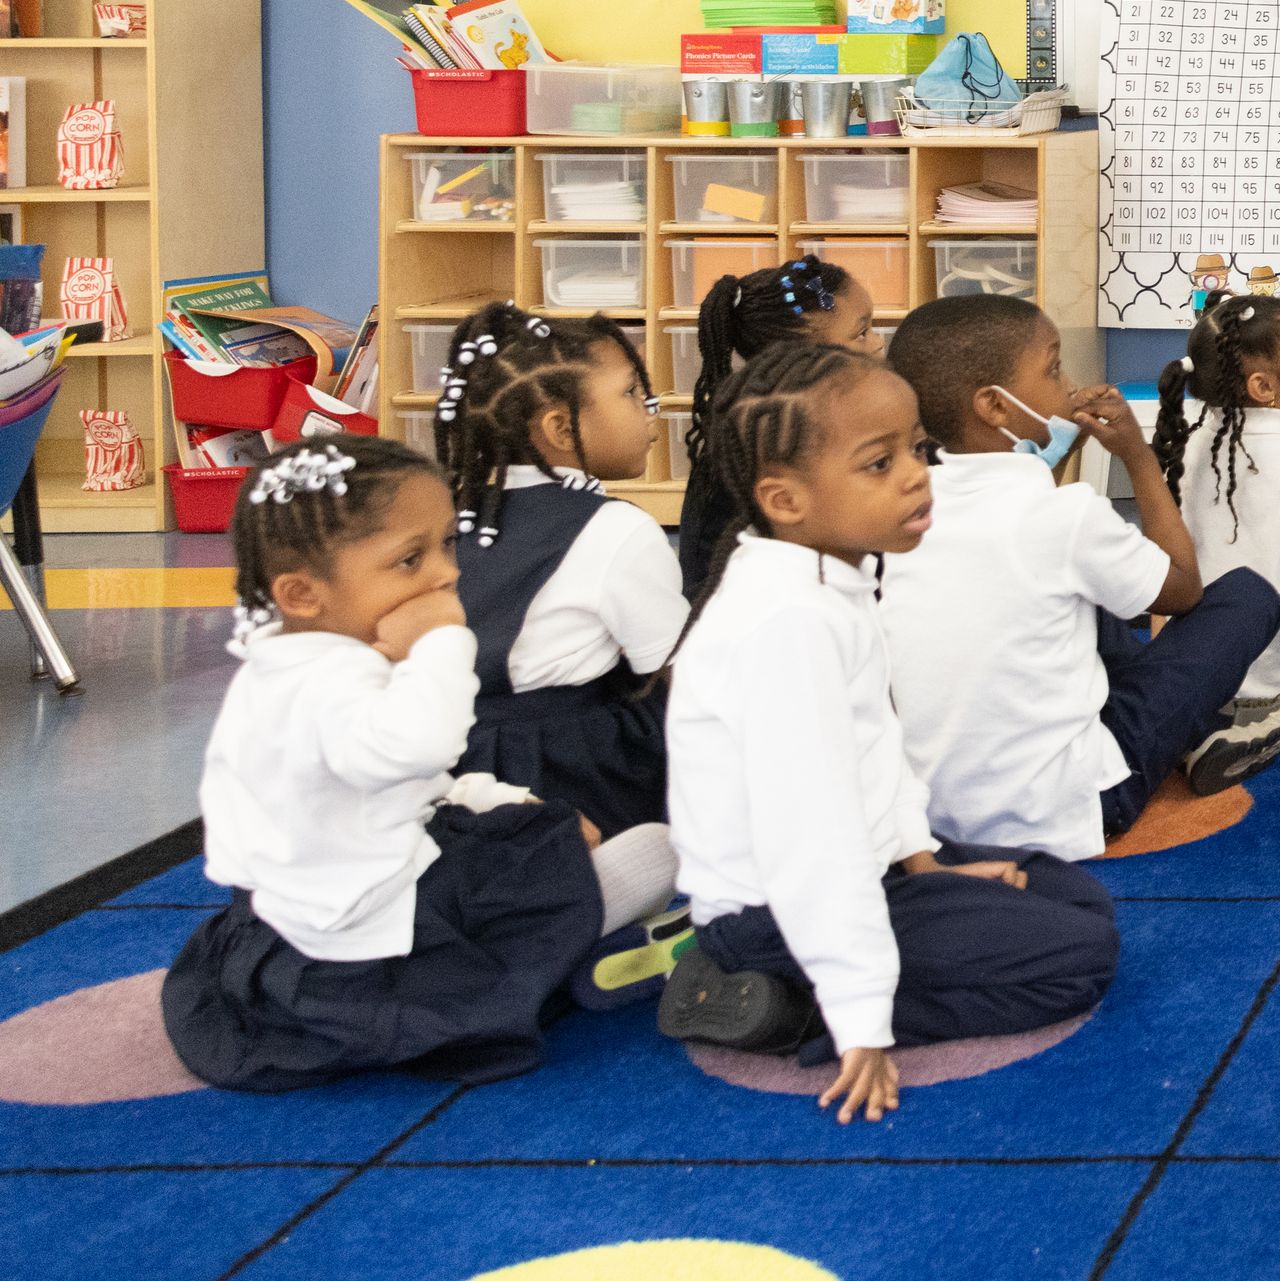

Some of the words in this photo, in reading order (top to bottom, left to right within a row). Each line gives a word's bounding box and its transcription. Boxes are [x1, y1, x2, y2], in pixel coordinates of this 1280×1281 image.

[1251, 59, 1266, 71] 45
[75, 114, 95, 122] POP
[69, 123, 99, 132] CORN
[1151, 130, 1165, 143] 72
[1120, 207, 1133, 219] 101
[1239, 208, 1259, 220] 105
[188, 295, 215, 306] MAKE
[216, 291, 234, 302] WAY
[236, 287, 254, 298] FOR
